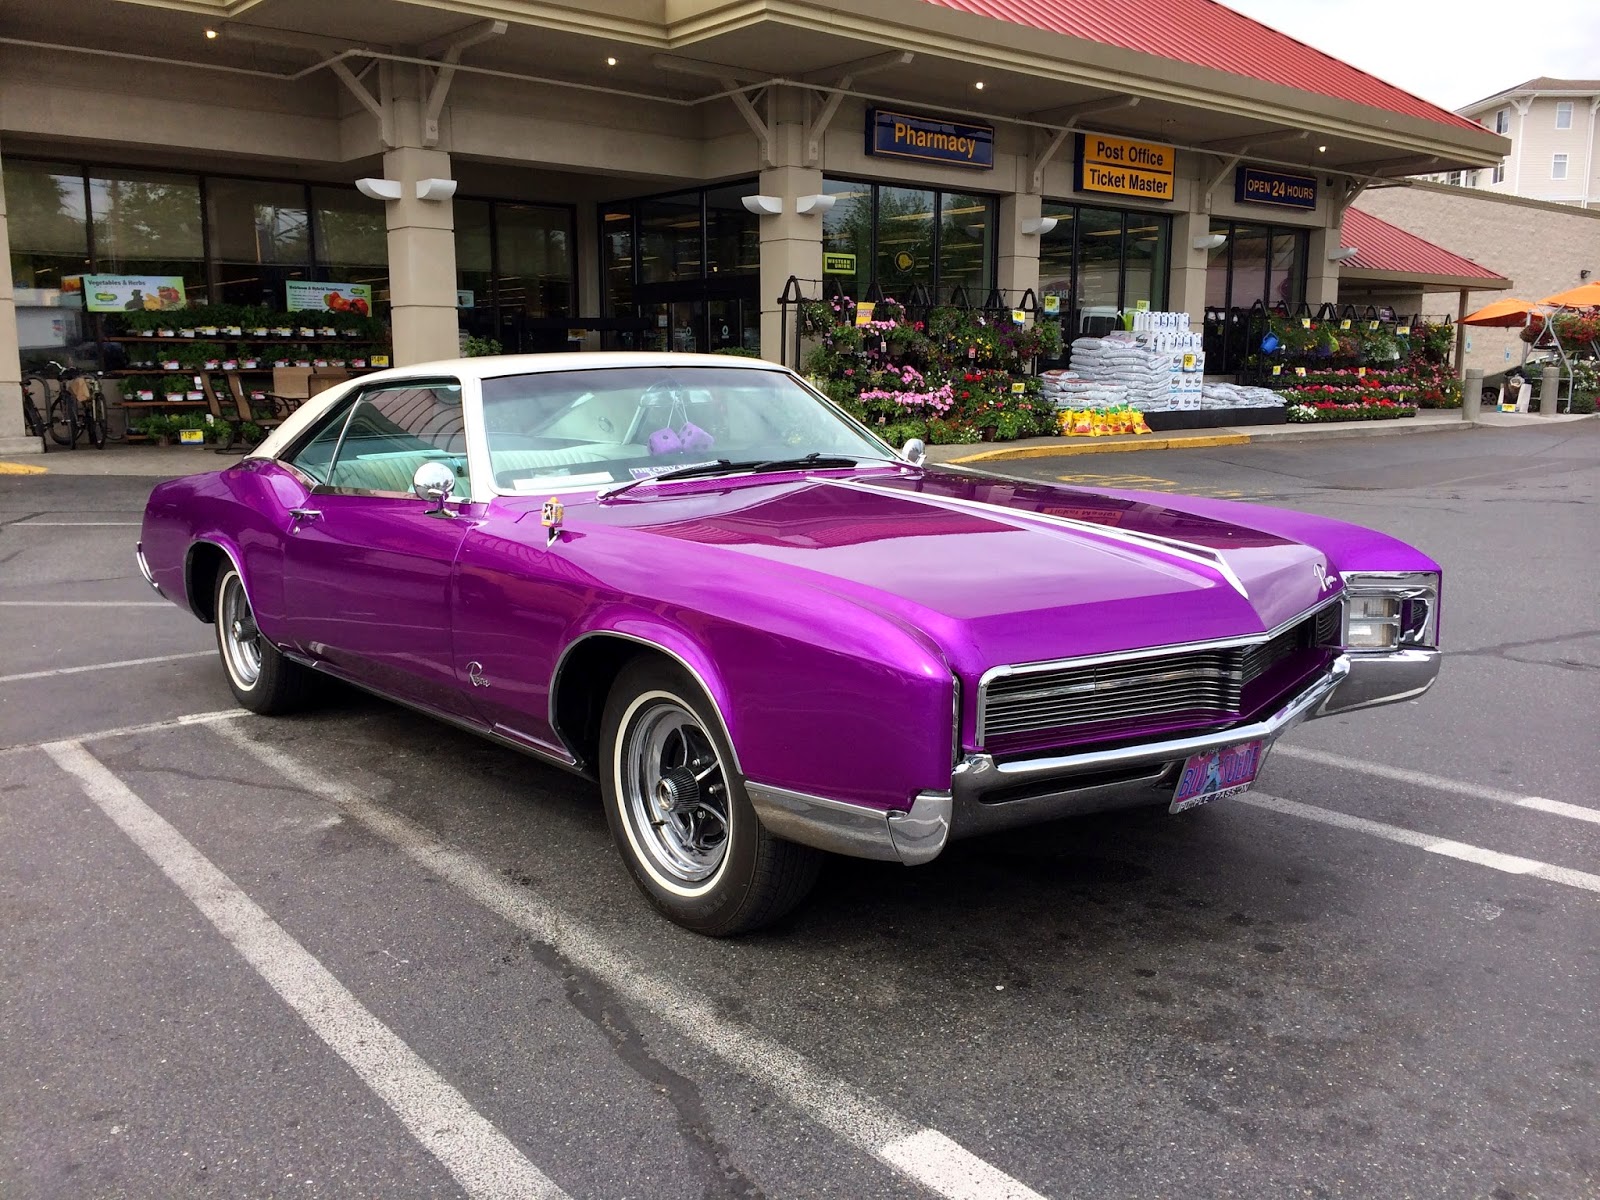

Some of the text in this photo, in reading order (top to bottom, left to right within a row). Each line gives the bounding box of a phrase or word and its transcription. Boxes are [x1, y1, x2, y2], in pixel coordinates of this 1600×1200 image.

[894, 122, 976, 159] Pharmacy
[1096, 141, 1164, 167] Post Office
[1089, 168, 1168, 194] Ticket Master
[1247, 179, 1314, 200] OPEN 24 HOURS
[632, 467, 651, 475] THE
[653, 464, 677, 473] ONLY
[1222, 745, 1259, 784] SUEDE
[1213, 783, 1250, 801] PASSION
